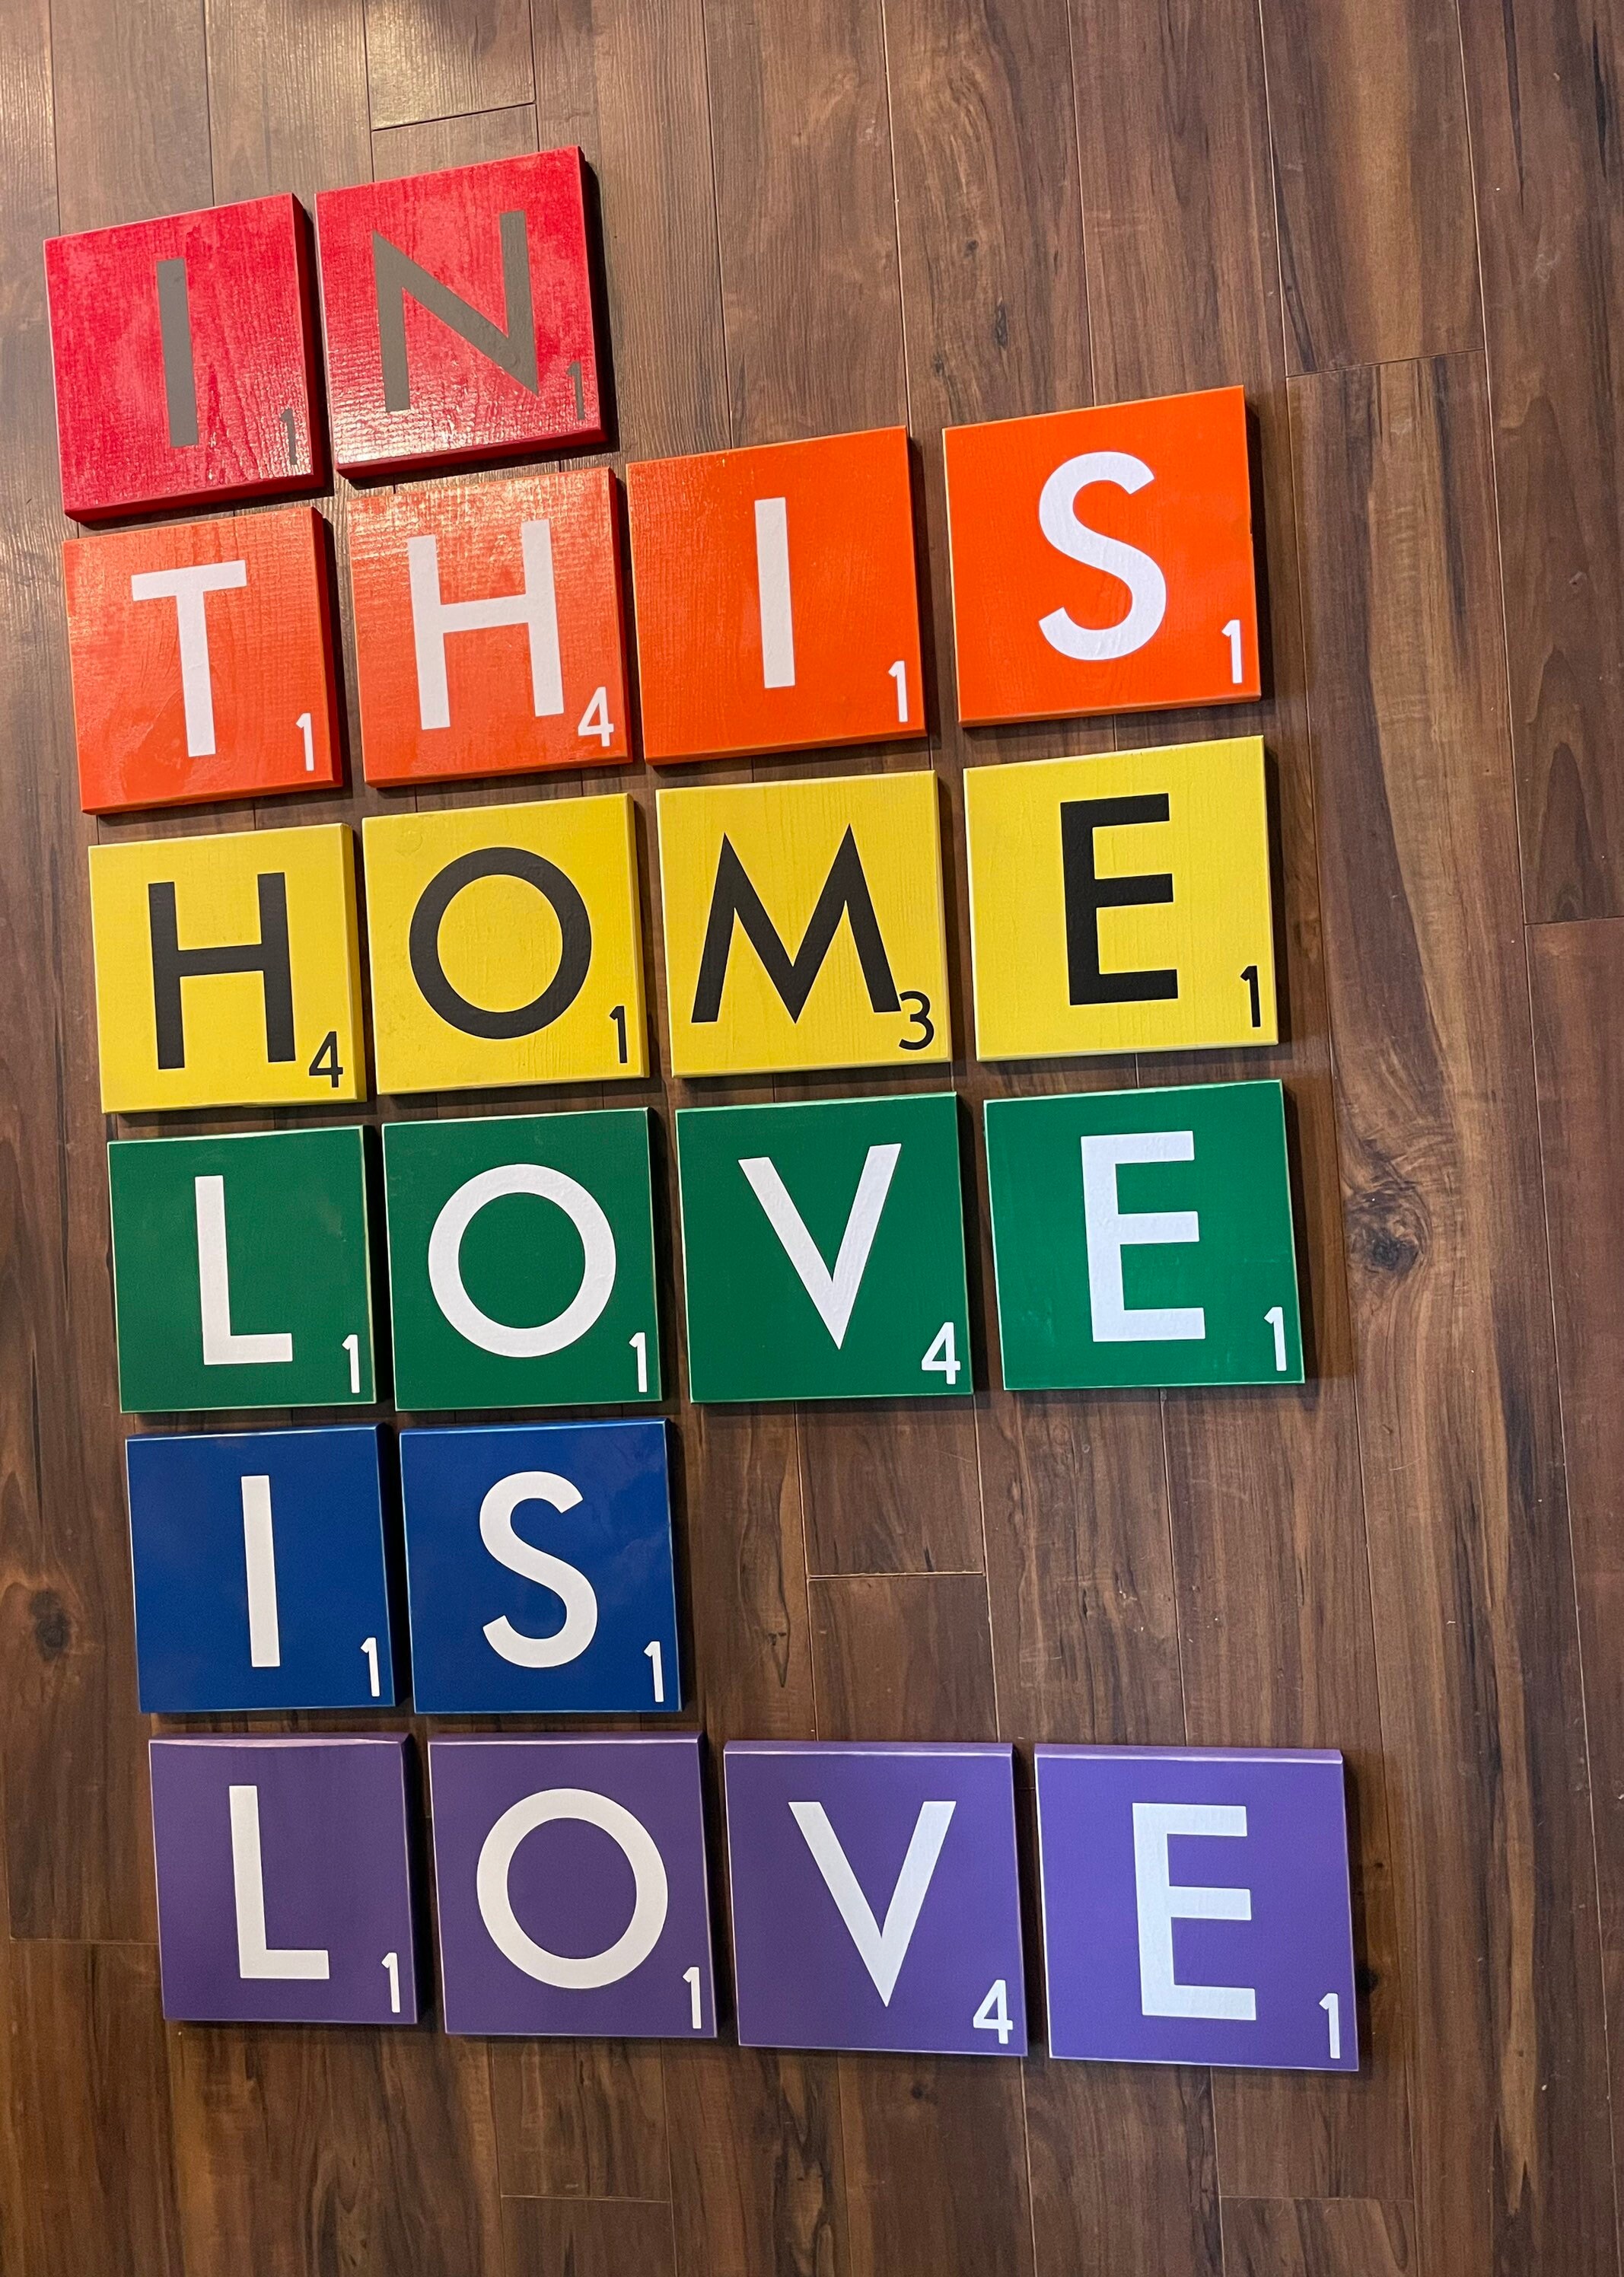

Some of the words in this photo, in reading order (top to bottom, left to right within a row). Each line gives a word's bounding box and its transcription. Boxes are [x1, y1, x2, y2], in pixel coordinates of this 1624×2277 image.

[567, 361, 585, 420] 1
[280, 407, 298, 466] 1
[1221, 619, 1243, 684] 1
[578, 686, 614, 747] 4
[888, 661, 908, 722] 1
[296, 712, 314, 772] 1
[899, 990, 935, 1050] 3
[1240, 965, 1261, 1027] 1
[308, 1031, 343, 1088] 4
[610, 1005, 628, 1064] 1
[342, 1334, 361, 1393] 1
[629, 1332, 648, 1393] 1
[921, 1321, 961, 1385] 4
[1264, 1306, 1287, 1371] 1
[361, 1637, 381, 1697] 1
[644, 1641, 664, 1702] 1
[381, 1952, 401, 2013] 1
[682, 1966, 702, 2030] 1
[973, 1979, 1014, 2045] 4
[1319, 1992, 1341, 2059] 1
